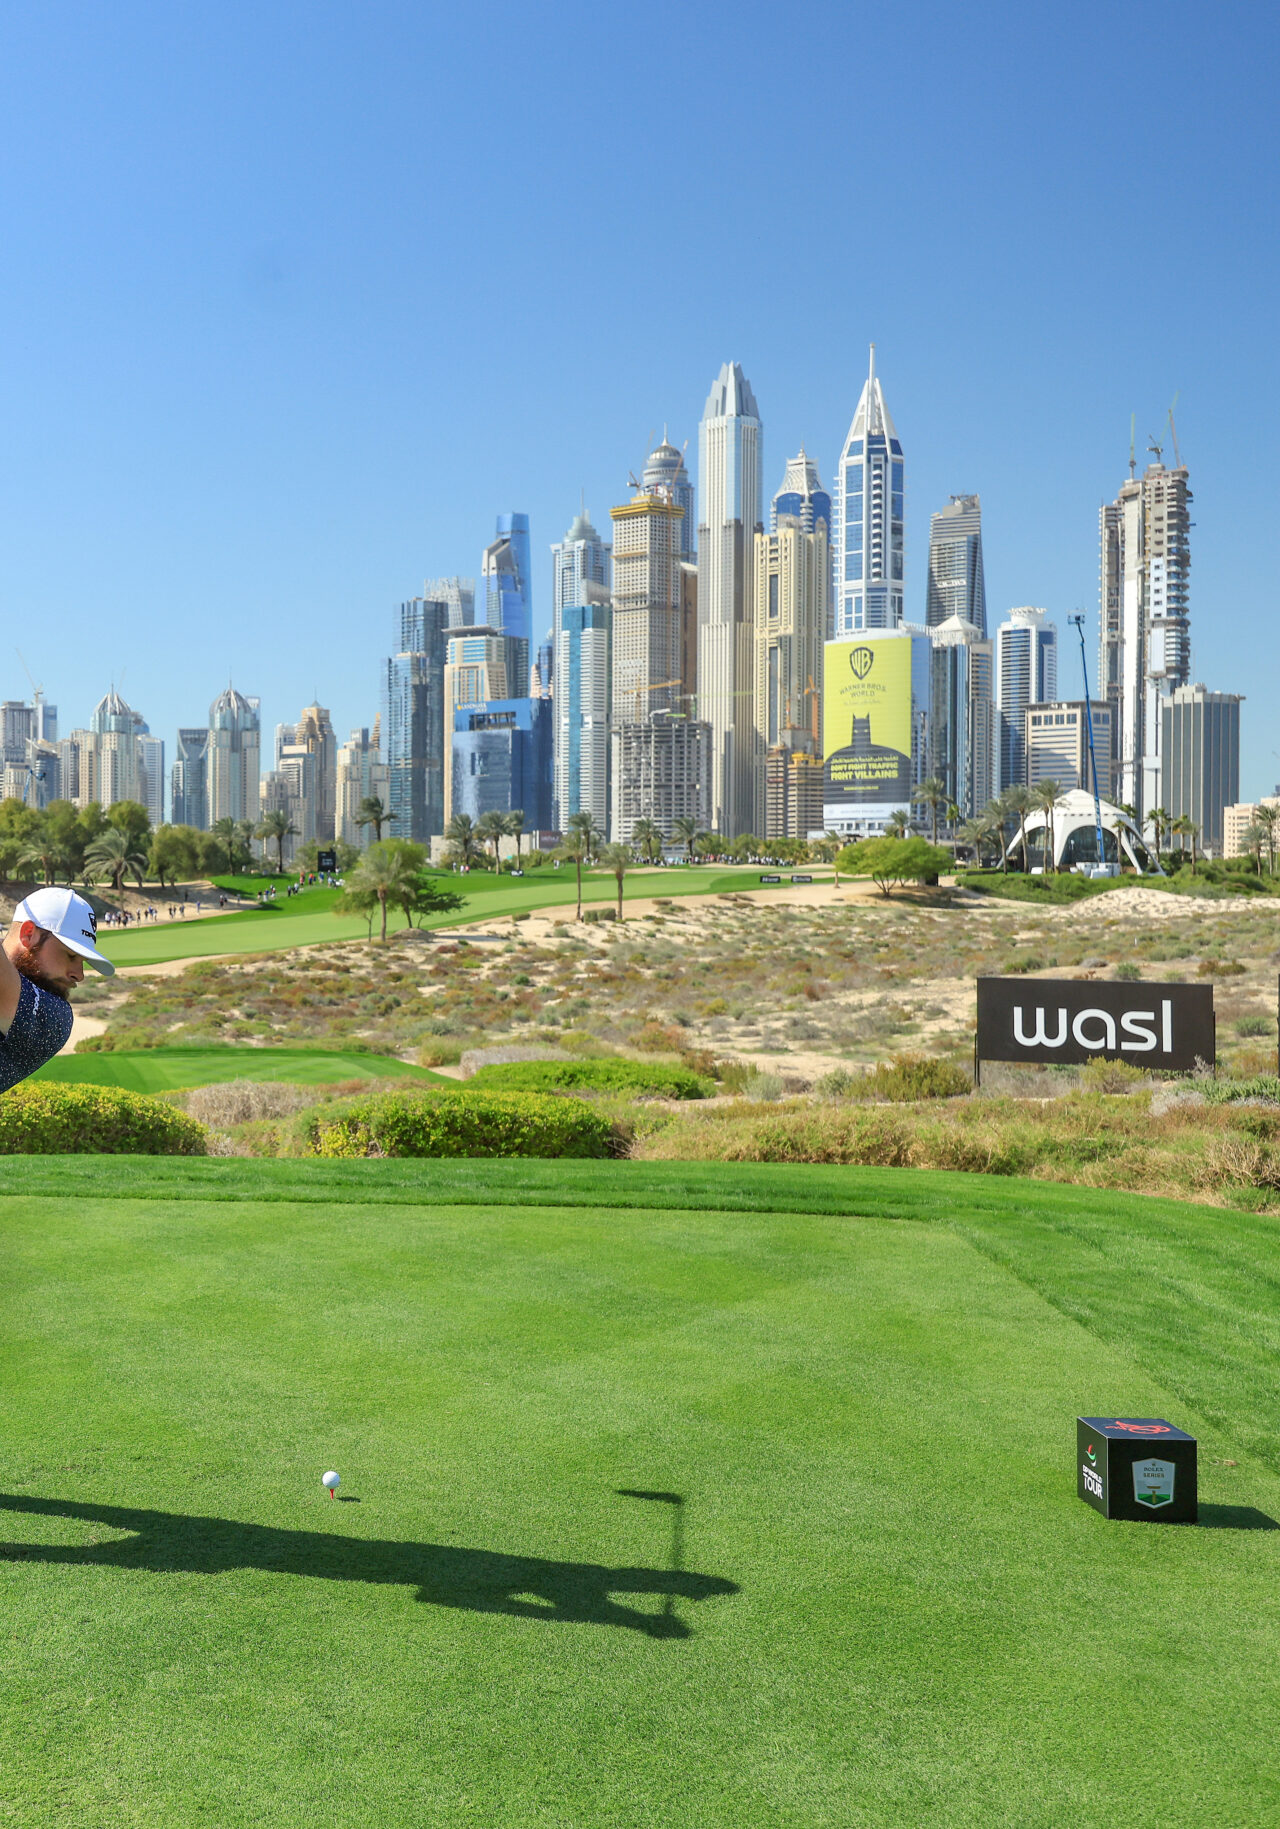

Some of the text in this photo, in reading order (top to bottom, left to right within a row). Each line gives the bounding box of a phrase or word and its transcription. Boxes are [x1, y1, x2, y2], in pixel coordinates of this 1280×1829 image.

[855, 770, 898, 779] VILLAINS
[1013, 1000, 1172, 1053] wasl
[1082, 1472, 1103, 1500] TOUR
